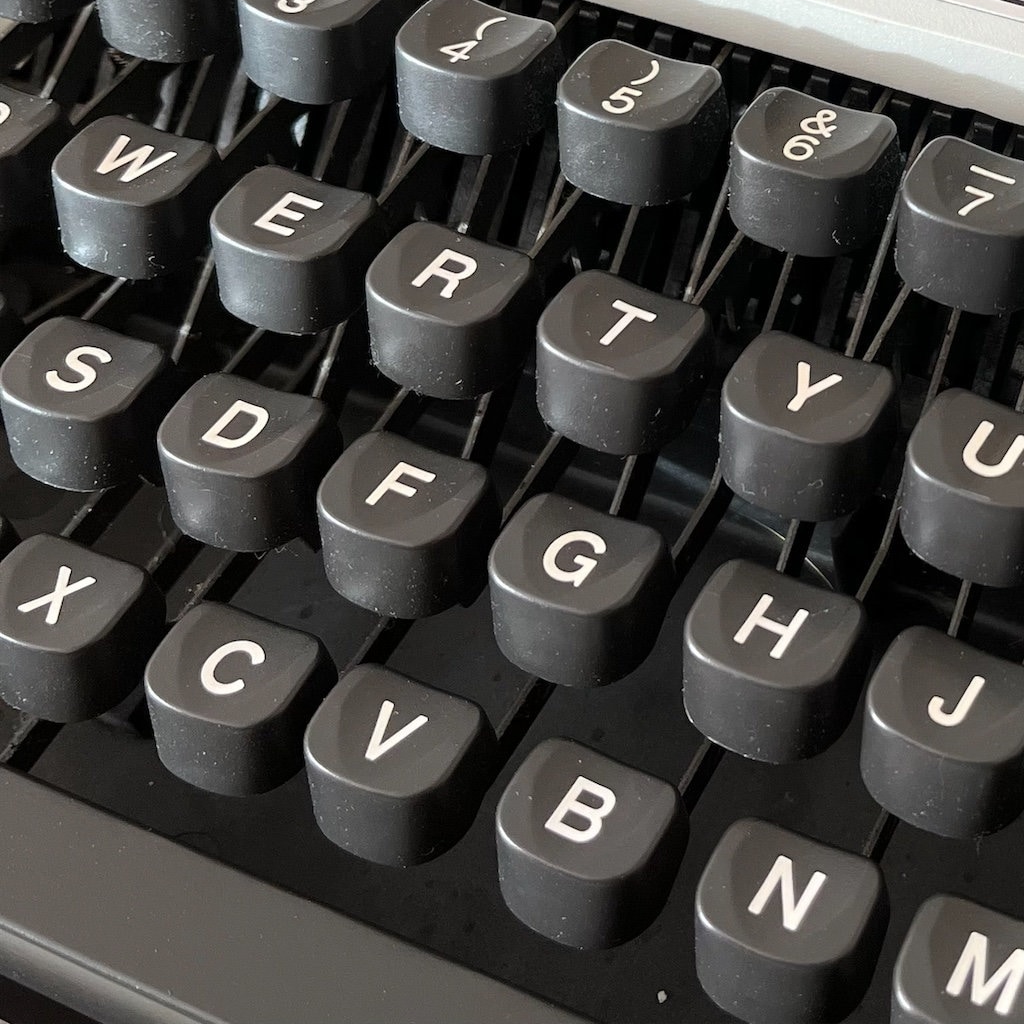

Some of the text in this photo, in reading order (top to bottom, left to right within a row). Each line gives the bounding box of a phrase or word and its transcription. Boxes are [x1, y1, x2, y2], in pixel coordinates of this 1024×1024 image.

[439, 40, 479, 63] 4
[601, 86, 643, 114] 5
[799, 109, 838, 139] &
[95, 134, 178, 183] W
[782, 134, 821, 161] 6
[253, 192, 324, 237] E
[957, 185, 995, 217] 7
[411, 248, 478, 299] R
[599, 299, 657, 346] T
[45, 346, 112, 393] S
[787, 361, 843, 412] Y
[201, 399, 269, 449] D
[365, 461, 436, 506] F
[542, 530, 607, 588] G
[17, 565, 97, 626] X
[733, 594, 810, 660] H
[200, 640, 266, 696] C
[927, 675, 986, 727] J
[364, 700, 429, 762] V
[544, 775, 617, 844] B
[747, 855, 827, 932] N
